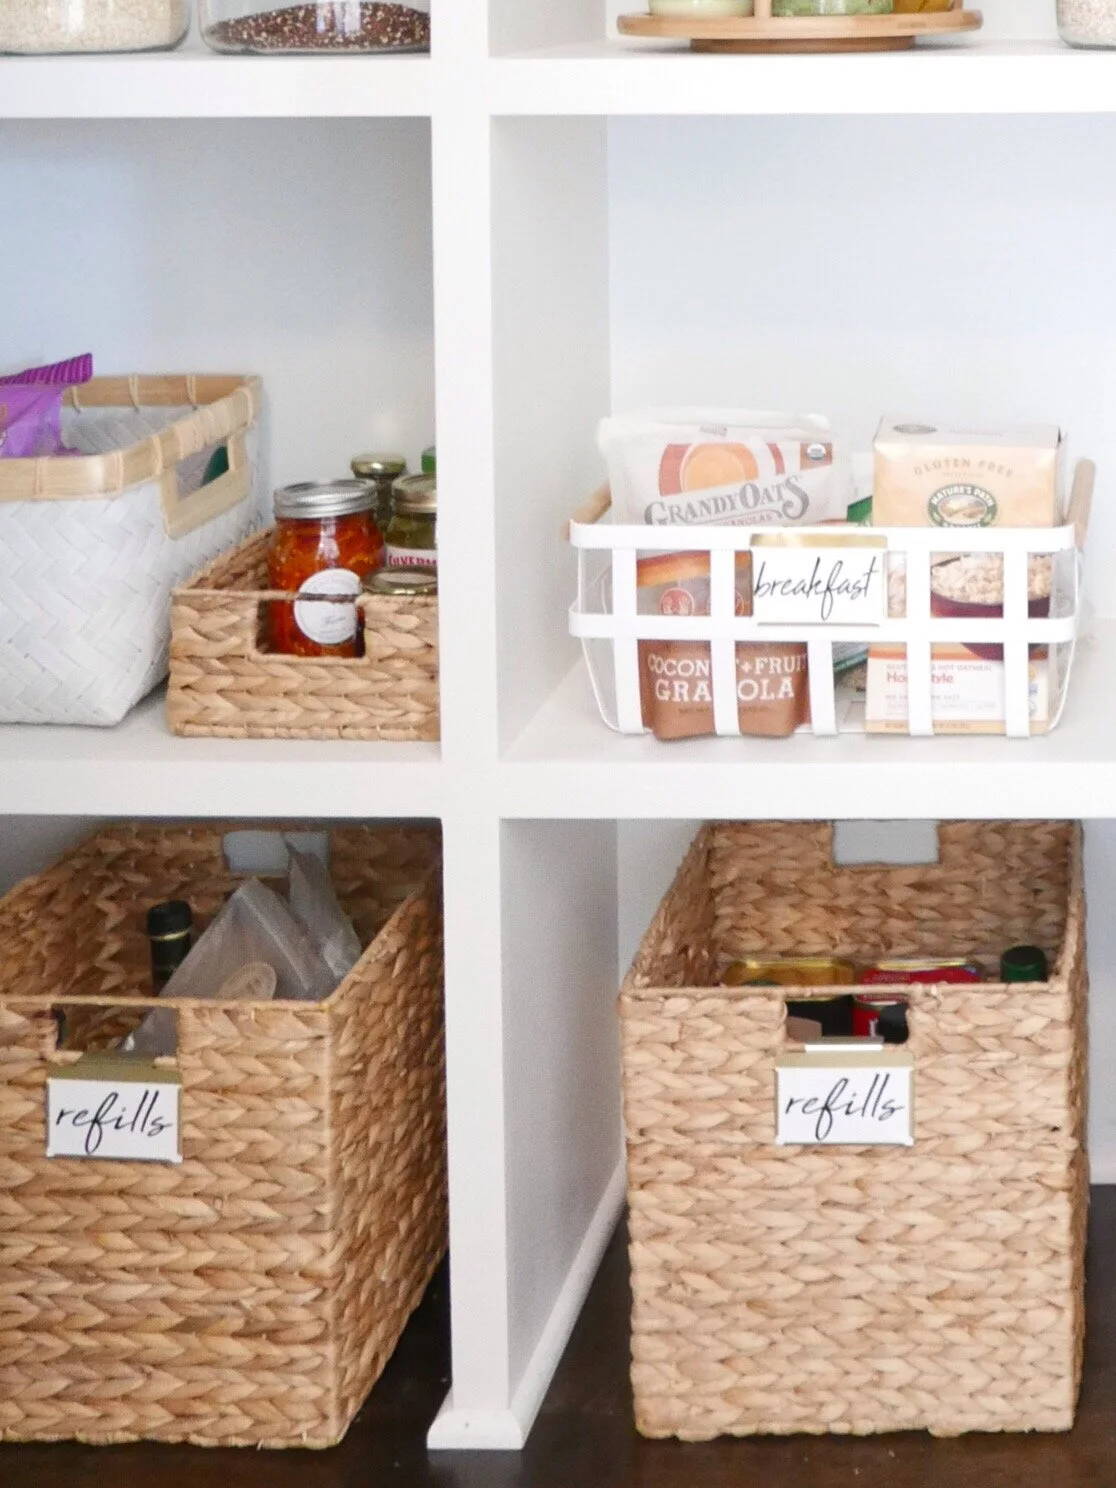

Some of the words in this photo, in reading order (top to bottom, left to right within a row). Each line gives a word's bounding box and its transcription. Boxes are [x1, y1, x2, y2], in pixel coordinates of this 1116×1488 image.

[914, 457, 971, 476] GLUTEN
[978, 460, 1014, 479] FREE
[931, 485, 972, 506] NATURE'S
[973, 487, 996, 507] PATH
[752, 554, 878, 621] breakfast
[647, 653, 714, 677] COCON
[655, 676, 795, 703] GRAOLA
[886, 671, 955, 686] Hotyle
[785, 1073, 906, 1142] refills
[56, 1089, 173, 1155] refills
